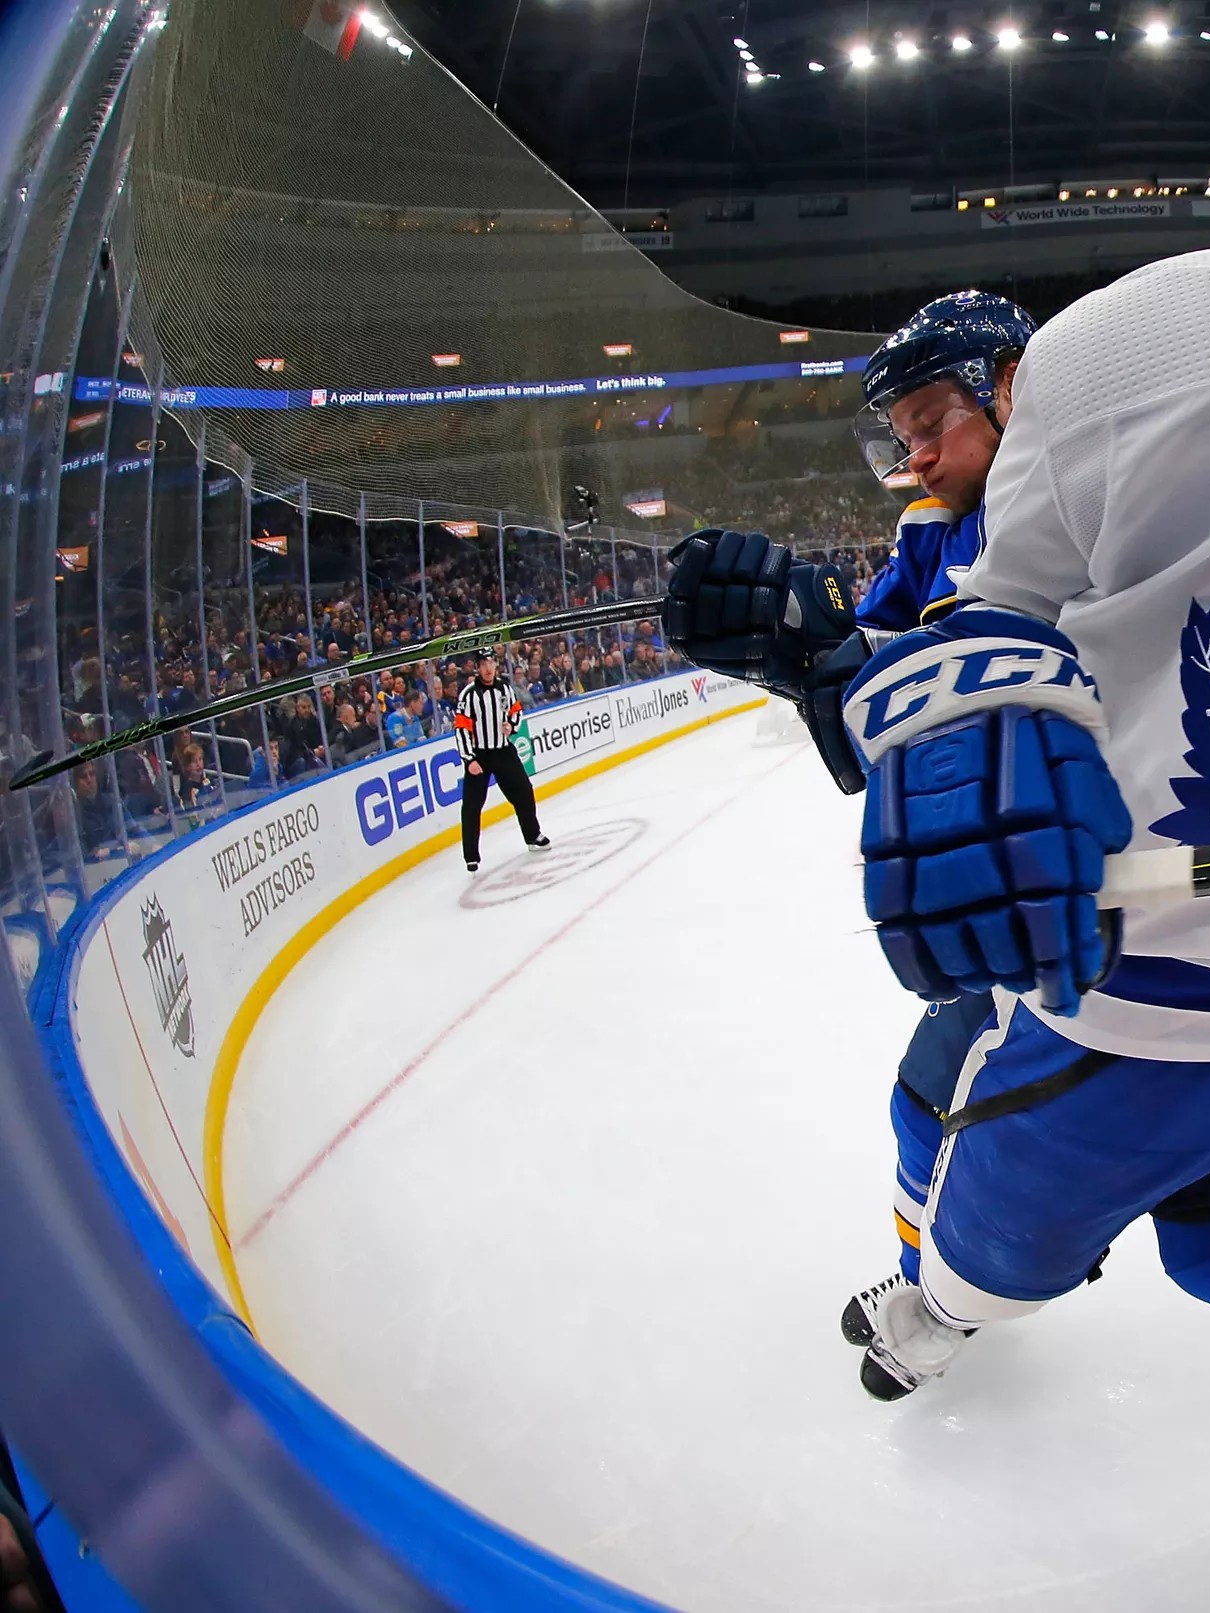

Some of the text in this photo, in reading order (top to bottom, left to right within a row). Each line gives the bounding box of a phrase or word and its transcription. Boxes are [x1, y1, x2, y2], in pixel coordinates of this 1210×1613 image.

[1016, 202, 1165, 222] World Wide Technology
[596, 376, 666, 390] Let's think big.
[866, 366, 889, 392] CCM
[330, 392, 338, 402] A
[340, 392, 363, 404] good
[363, 391, 385, 402] bank
[386, 393, 409, 402] never
[410, 390, 435, 401] treats
[443, 387, 466, 399] small
[468, 386, 505, 397] business
[507, 385, 522, 396] like
[523, 385, 545, 395] small
[828, 577, 845, 610] CCM
[355, 749, 496, 847] GEIC
[212, 803, 320, 892] WELLS FARGO
[240, 852, 315, 938] ADVISORS
